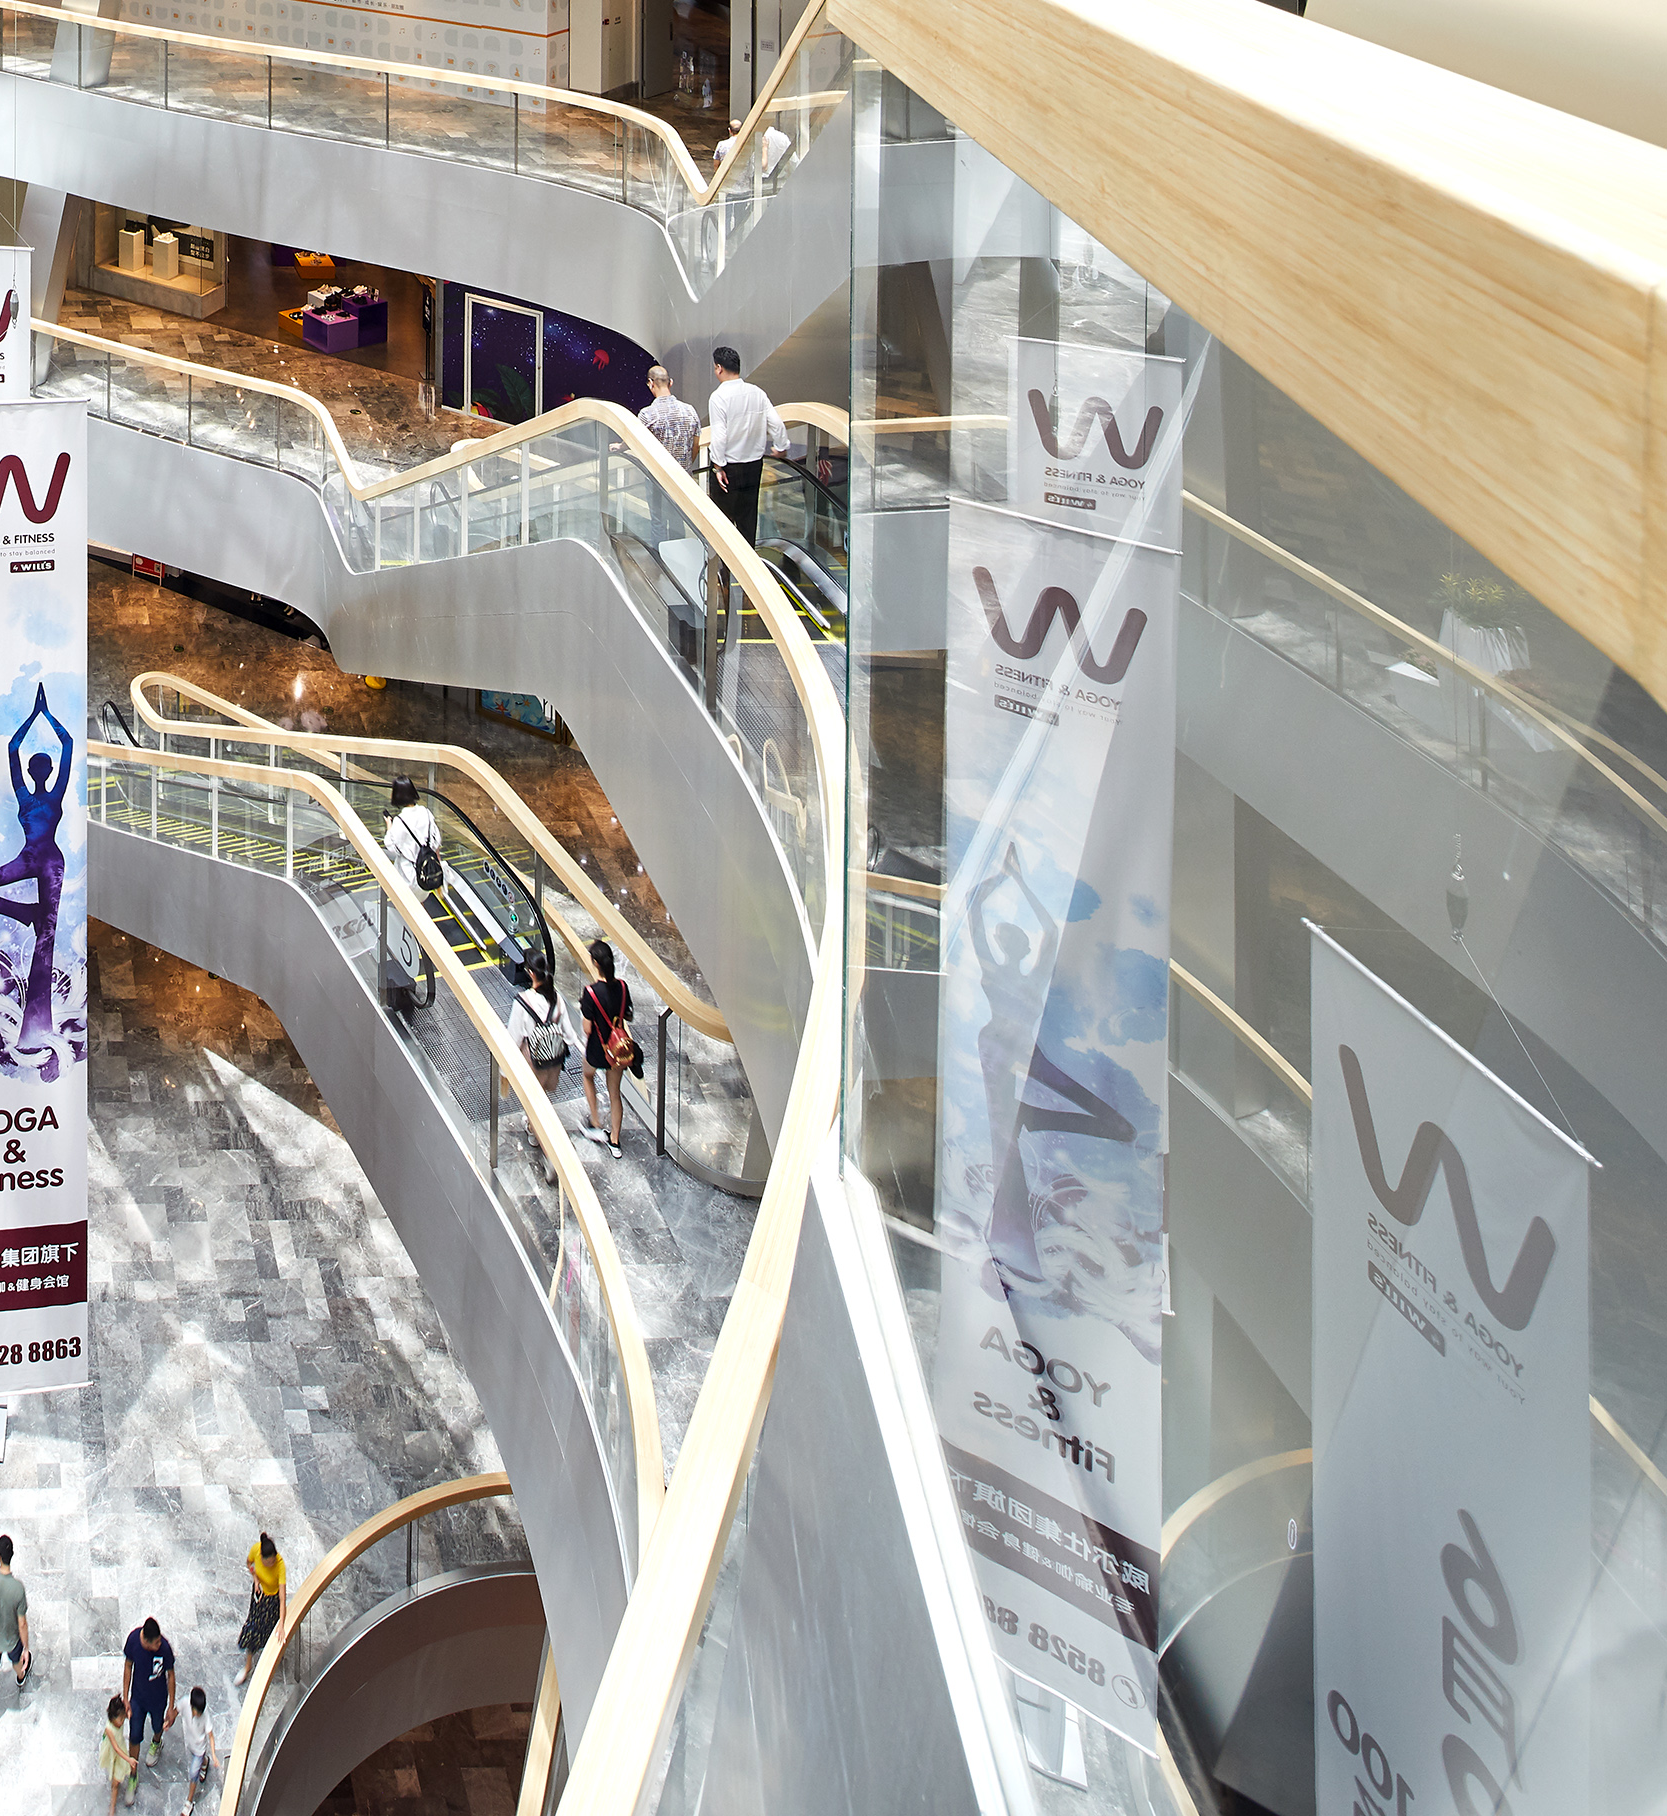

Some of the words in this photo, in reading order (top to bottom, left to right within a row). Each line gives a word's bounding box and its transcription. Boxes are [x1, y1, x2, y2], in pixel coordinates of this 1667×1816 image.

[2, 535, 11, 545] &
[14, 533, 55, 544] FITNESS
[25, 548, 56, 556] balanced
[399, 926, 413, 967] 5
[3, 1138, 26, 1164] &
[28, 1336, 82, 1364] 8863
